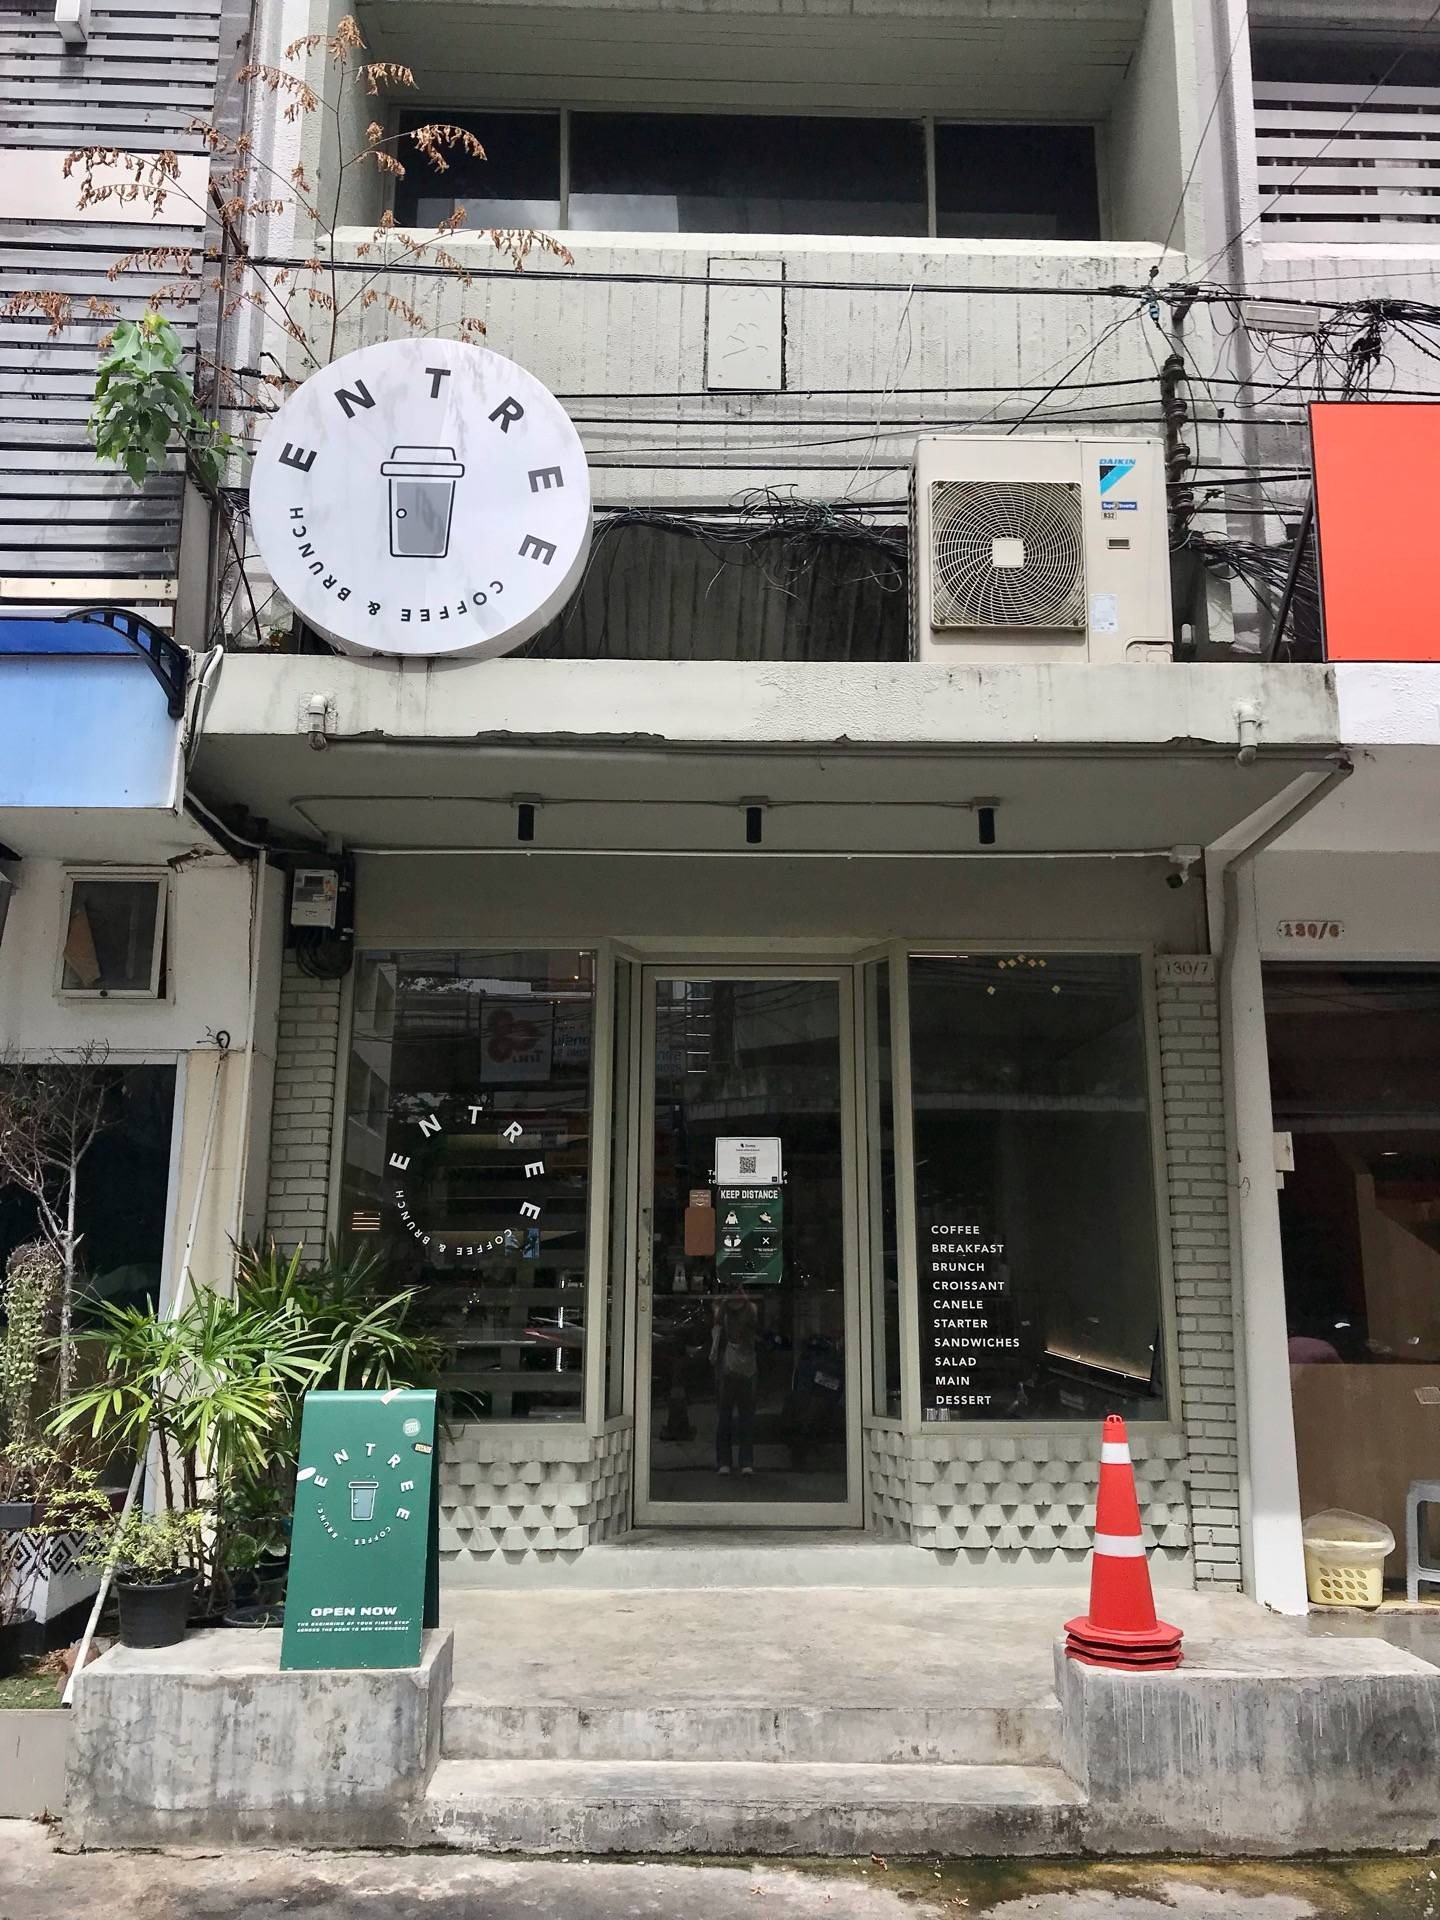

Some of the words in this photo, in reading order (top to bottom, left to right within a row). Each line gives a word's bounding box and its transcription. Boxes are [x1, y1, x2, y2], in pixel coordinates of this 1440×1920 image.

[279, 367, 564, 566] ENTREE
[289, 506, 352, 602] BRUNCH
[401, 580, 504, 622] COFFEE
[367, 600, 381, 616] &
[1283, 922, 1340, 940] 130/6
[1164, 961, 1210, 976] 130/7
[389, 1105, 545, 1220] ENTREE
[720, 1189, 740, 1199] KEEP
[741, 1189, 779, 1199] DISTANCE
[395, 1190, 431, 1245] BRUNCH
[931, 1225, 980, 1234] COFFEE
[456, 1228, 512, 1256] COFFEE
[438, 1243, 447, 1253] &
[932, 1243, 1004, 1253] BREAKFAST
[932, 1262, 985, 1272] BRUNCH
[933, 1281, 1005, 1290] CROISSANT
[933, 1300, 984, 1309] CANELE
[933, 1319, 988, 1328] STARTER
[934, 1338, 1020, 1347] SANDWICHES
[935, 1357, 977, 1366] SALAD
[935, 1376, 970, 1386] MAIN
[936, 1395, 992, 1405] DESSERT
[313, 1442, 414, 1521] ENTREE
[317, 1502, 338, 1539] BRUNC
[354, 1526, 391, 1546] COFFEE
[311, 1607, 356, 1617] OPEN
[360, 1606, 398, 1616] NOW
